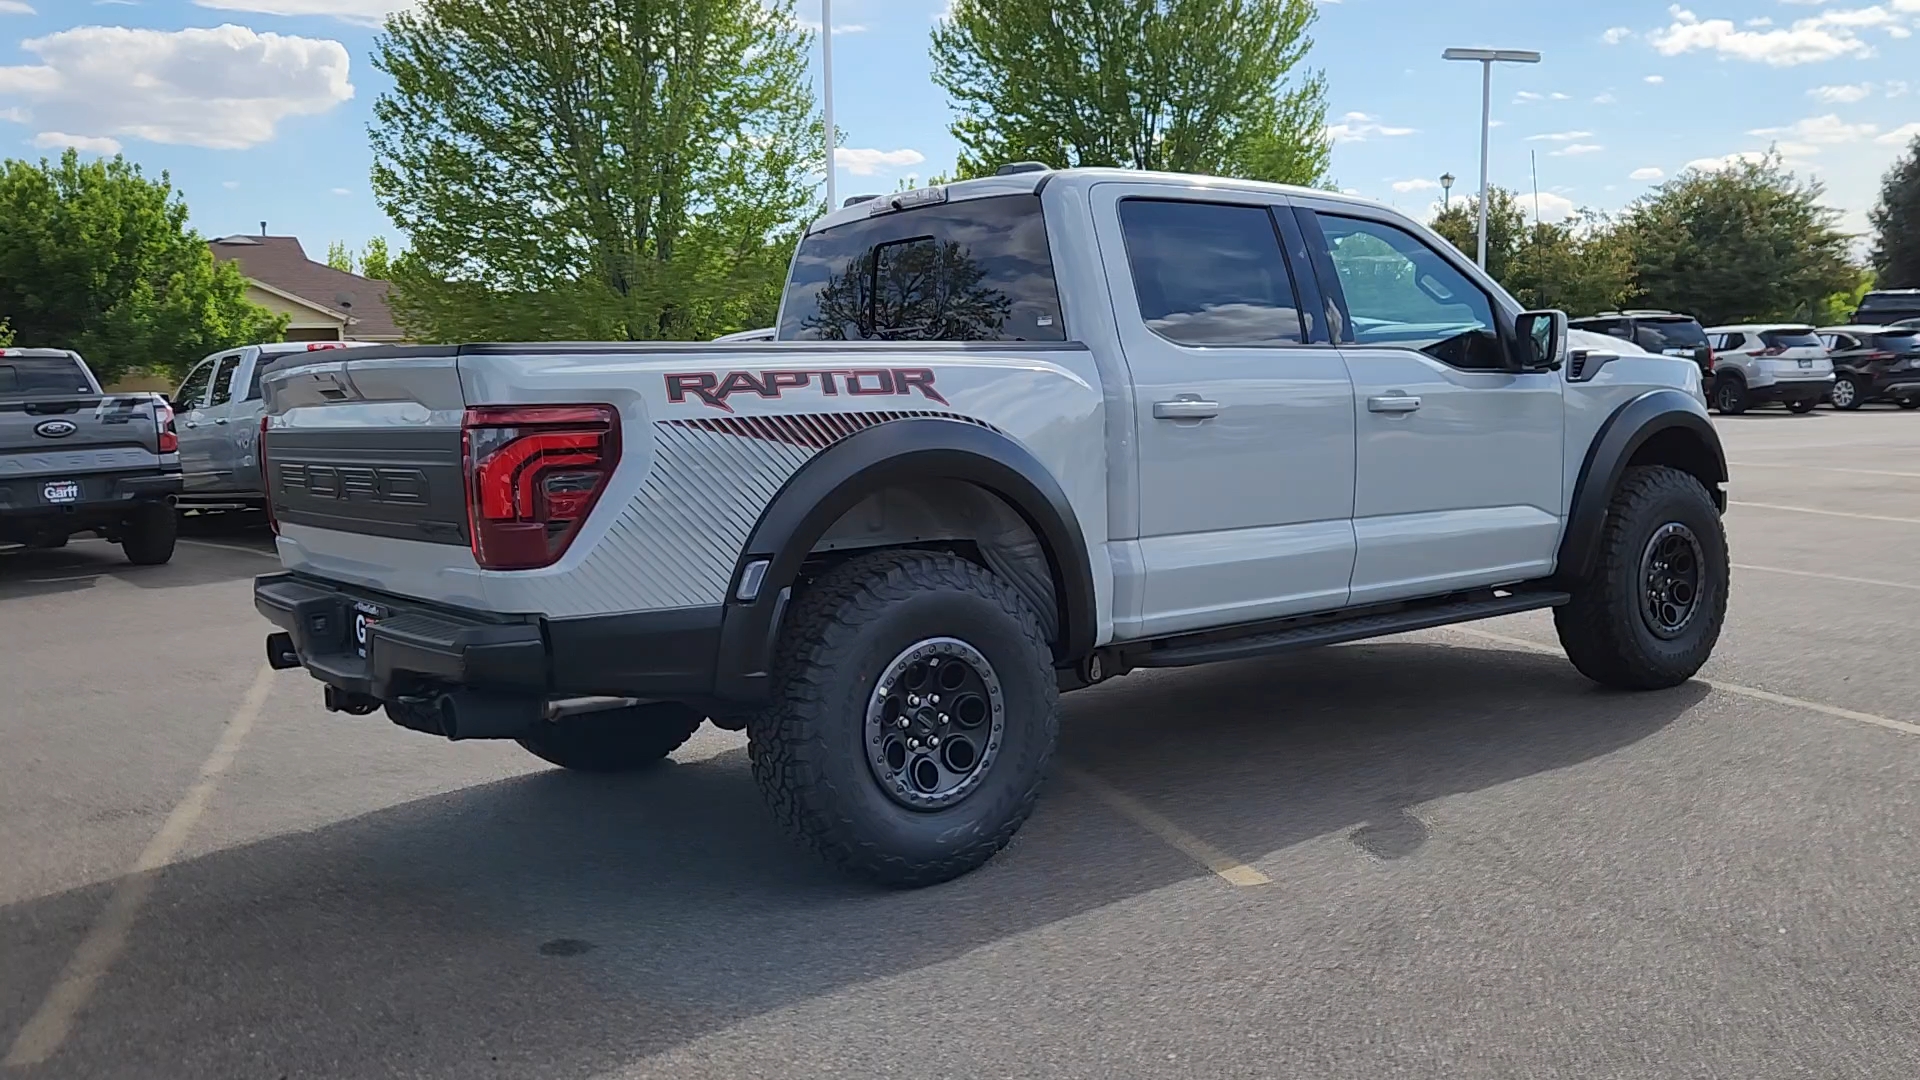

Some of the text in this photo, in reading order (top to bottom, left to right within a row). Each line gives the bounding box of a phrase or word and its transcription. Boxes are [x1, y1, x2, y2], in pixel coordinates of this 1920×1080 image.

[664, 368, 950, 413] RAPTOR
[44, 485, 78, 499] Garff
[279, 463, 430, 506] FORD
